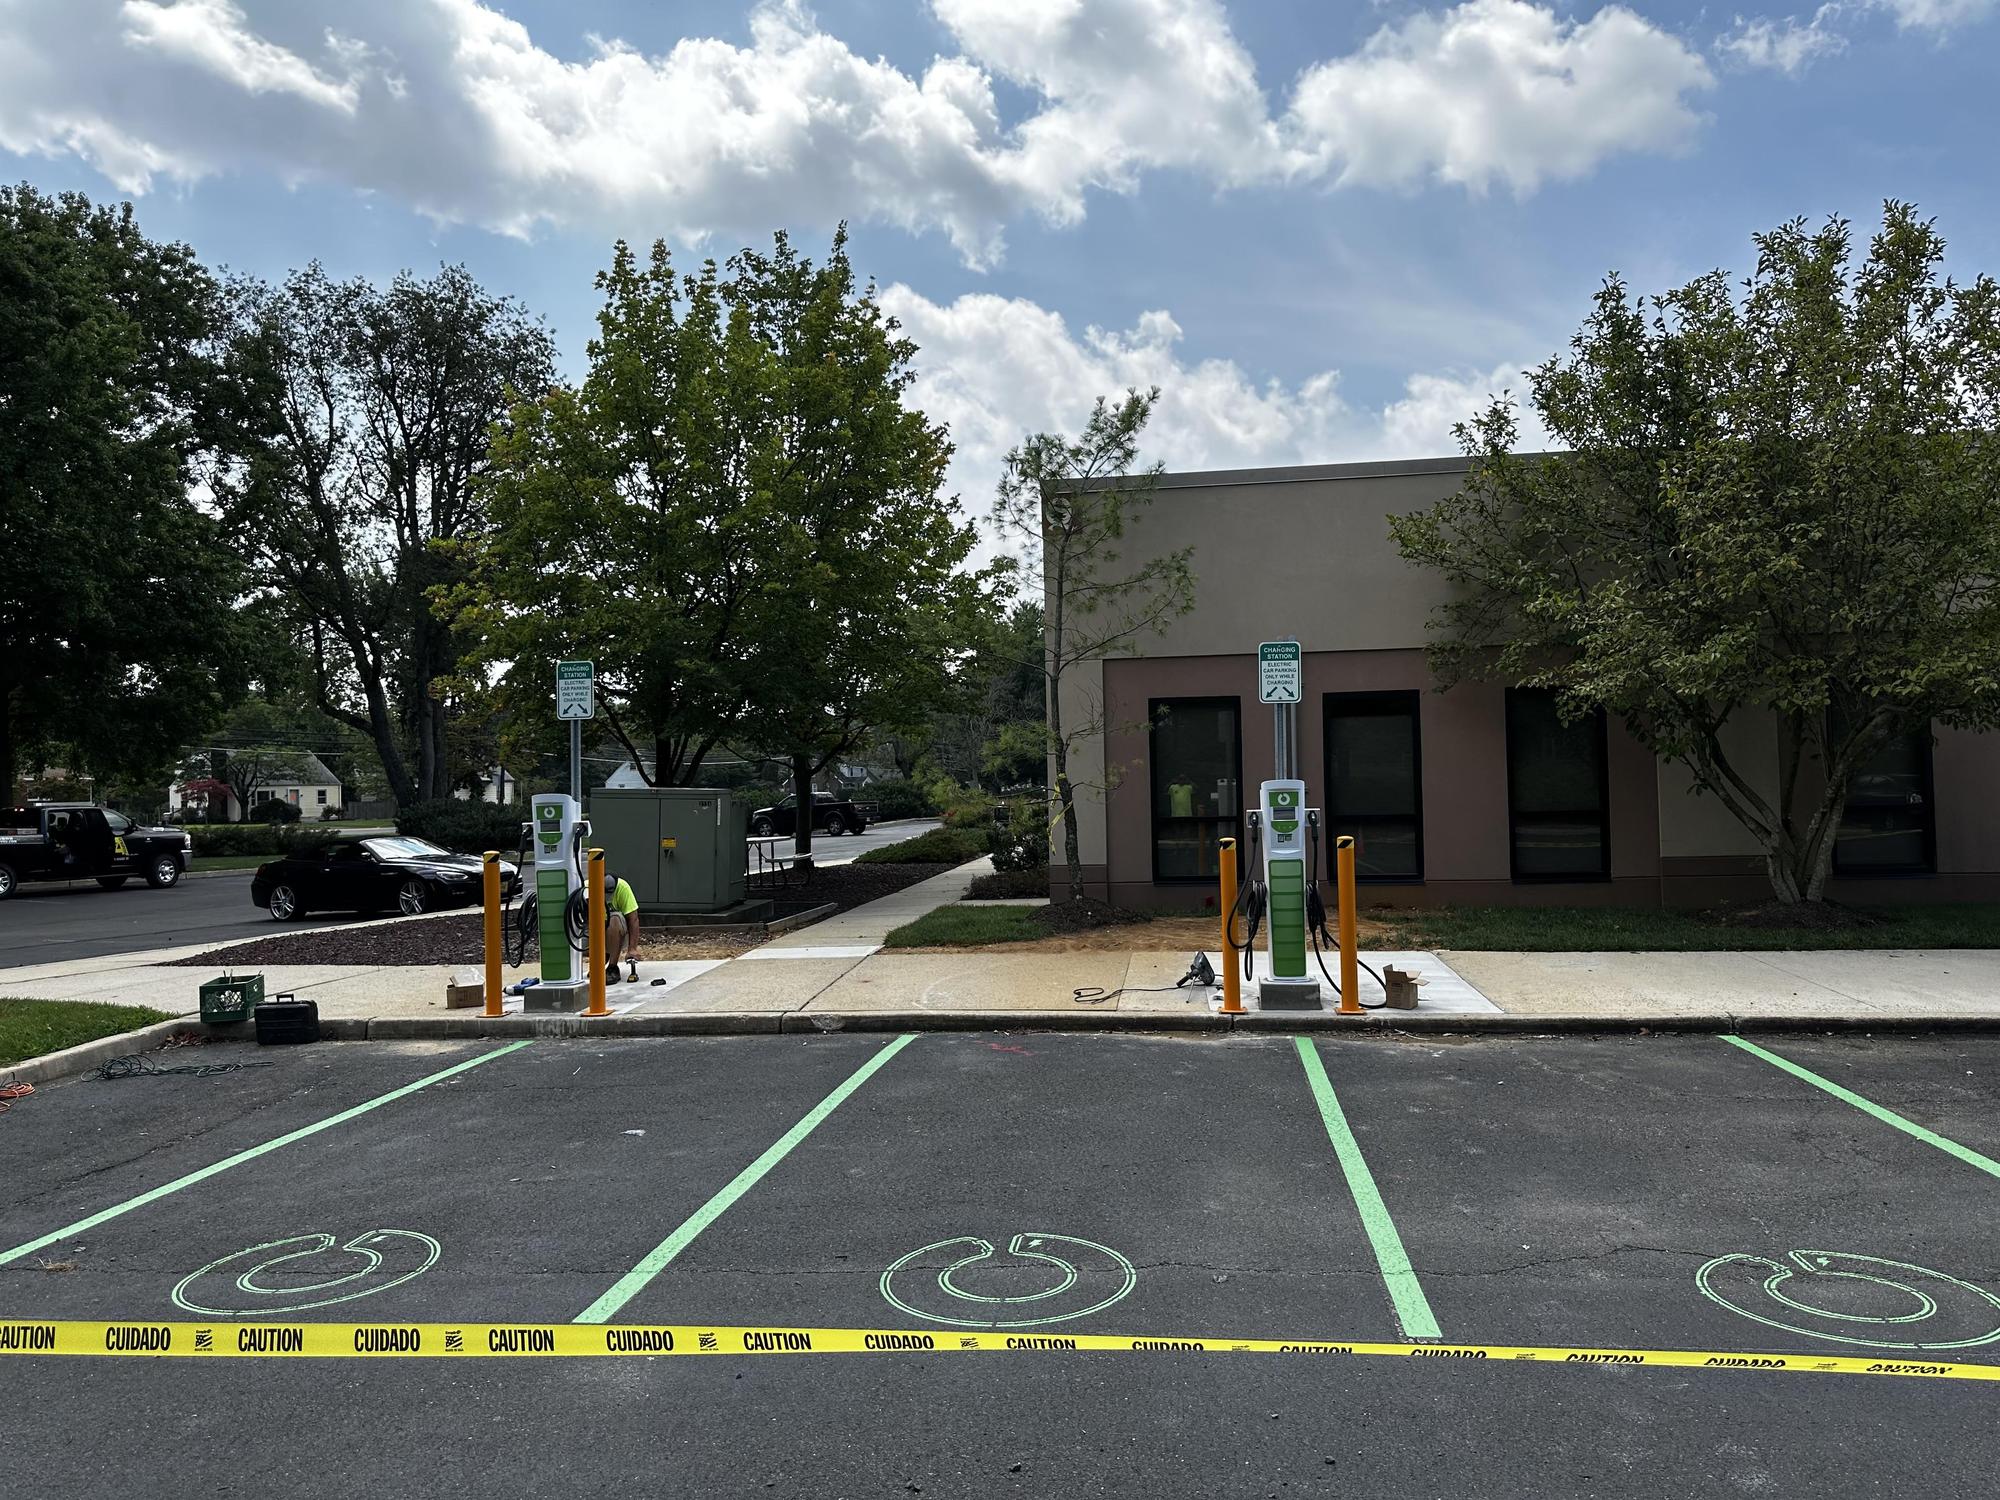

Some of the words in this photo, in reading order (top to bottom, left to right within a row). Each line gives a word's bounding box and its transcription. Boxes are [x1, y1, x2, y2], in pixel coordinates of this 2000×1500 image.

[0, 1326, 56, 1349] AUTION
[105, 1326, 171, 1351] CUIDADO
[238, 1328, 303, 1352] CAUTION
[354, 1328, 421, 1352] CUIDADO
[488, 1329, 555, 1352] CAUTION
[606, 1330, 674, 1352] CUIDADO
[743, 1332, 812, 1350] CAUTION
[864, 1334, 935, 1350] CUIDADO
[1006, 1337, 1076, 1350] CAUTION
[1132, 1341, 1204, 1351] CUIDADO
